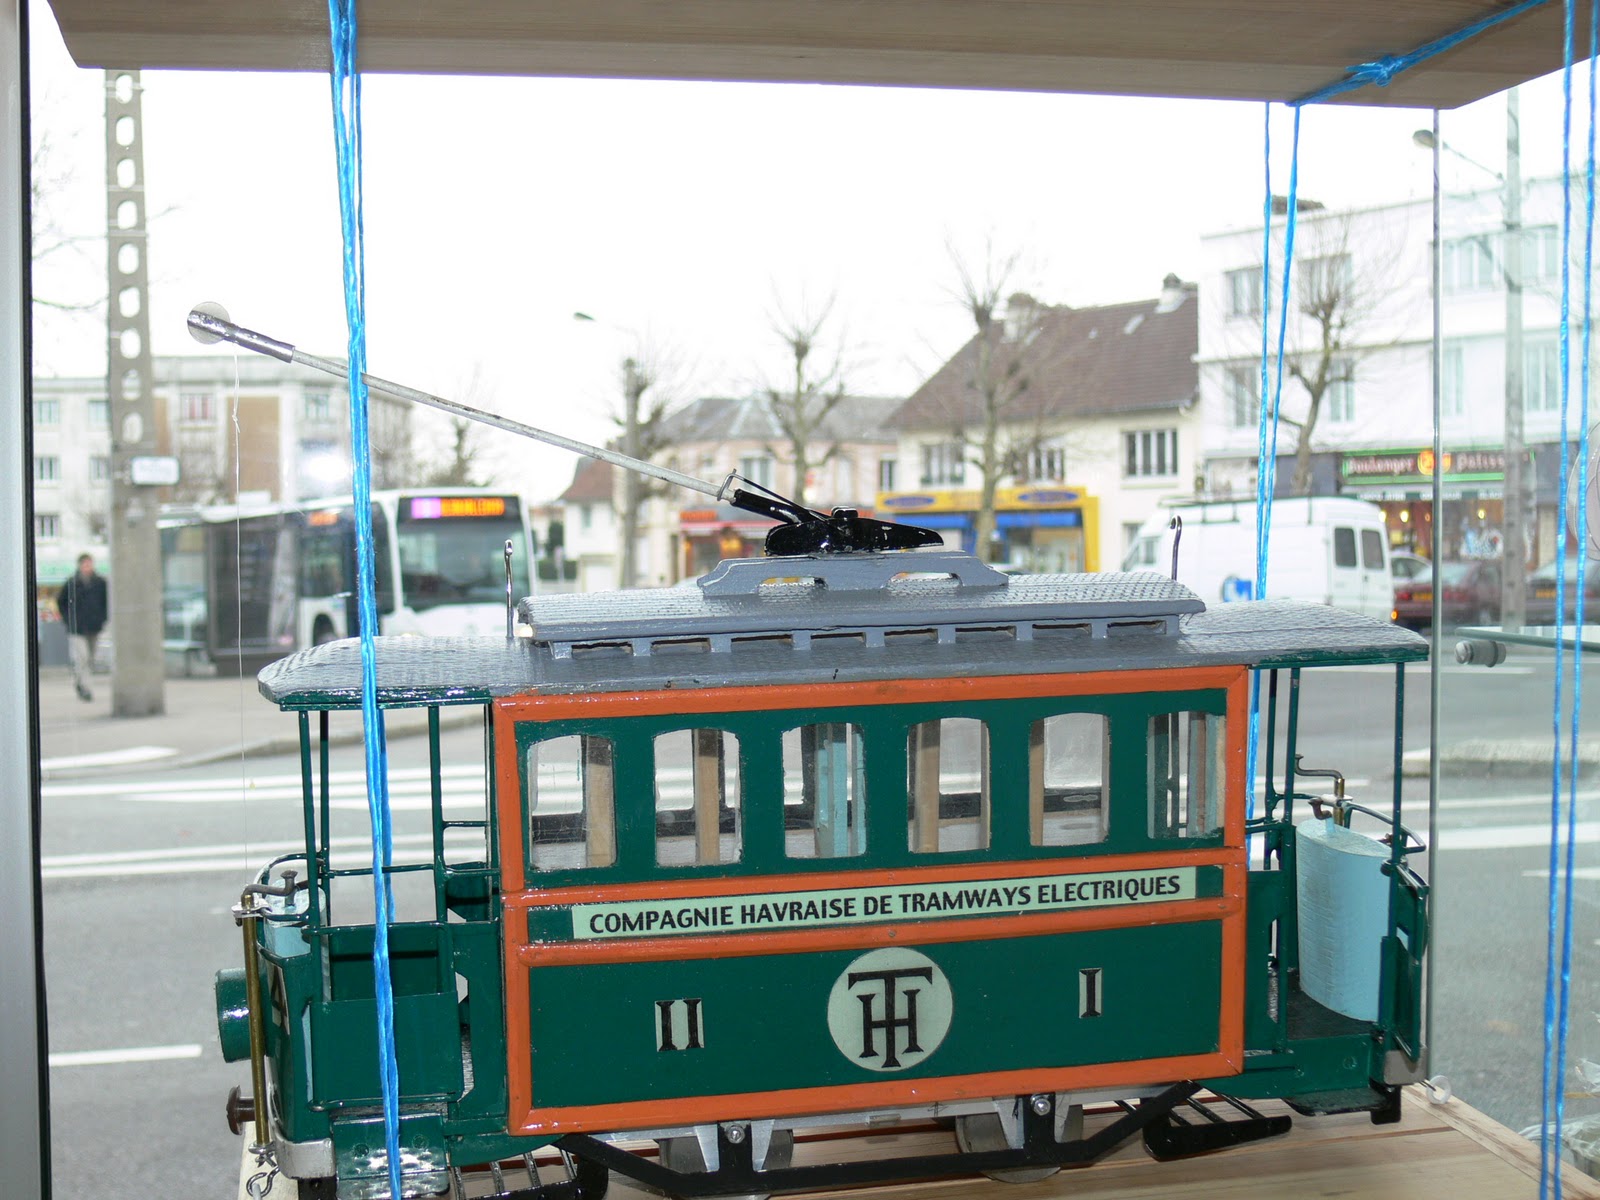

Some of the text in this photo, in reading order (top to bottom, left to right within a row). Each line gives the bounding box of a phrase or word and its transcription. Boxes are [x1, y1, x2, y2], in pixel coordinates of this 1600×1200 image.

[589, 875, 1181, 933] COMPAGNIE HAVRAISE DE TRAMWAYS ELECTRIQUES
